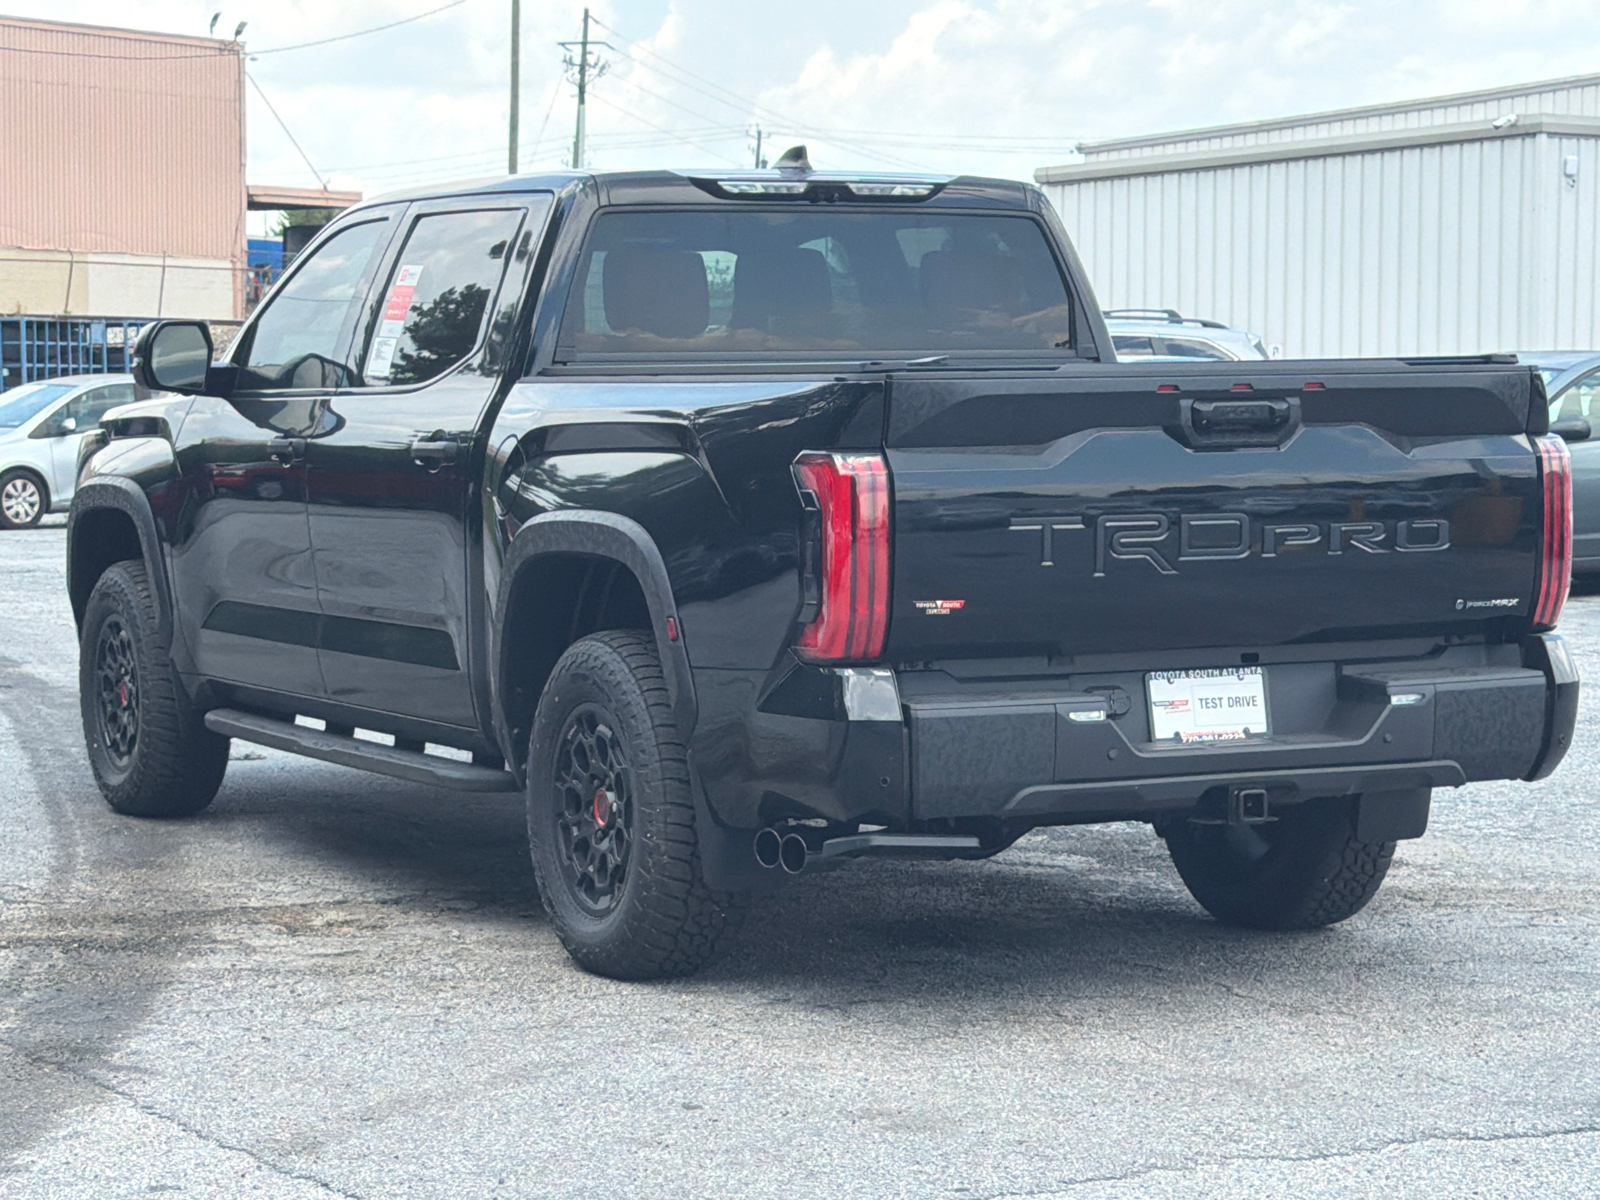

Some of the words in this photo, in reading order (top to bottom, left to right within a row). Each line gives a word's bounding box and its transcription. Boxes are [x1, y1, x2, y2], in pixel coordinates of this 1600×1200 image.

[1008, 513, 1251, 577] TRD
[1261, 518, 1451, 557] PRO
[1150, 671, 1187, 681] TOYOTA
[1188, 669, 1220, 679] SOUTH
[1222, 666, 1263, 677] ATLANTA
[1198, 697, 1224, 710] TEST
[1227, 695, 1259, 708] DRIVE
